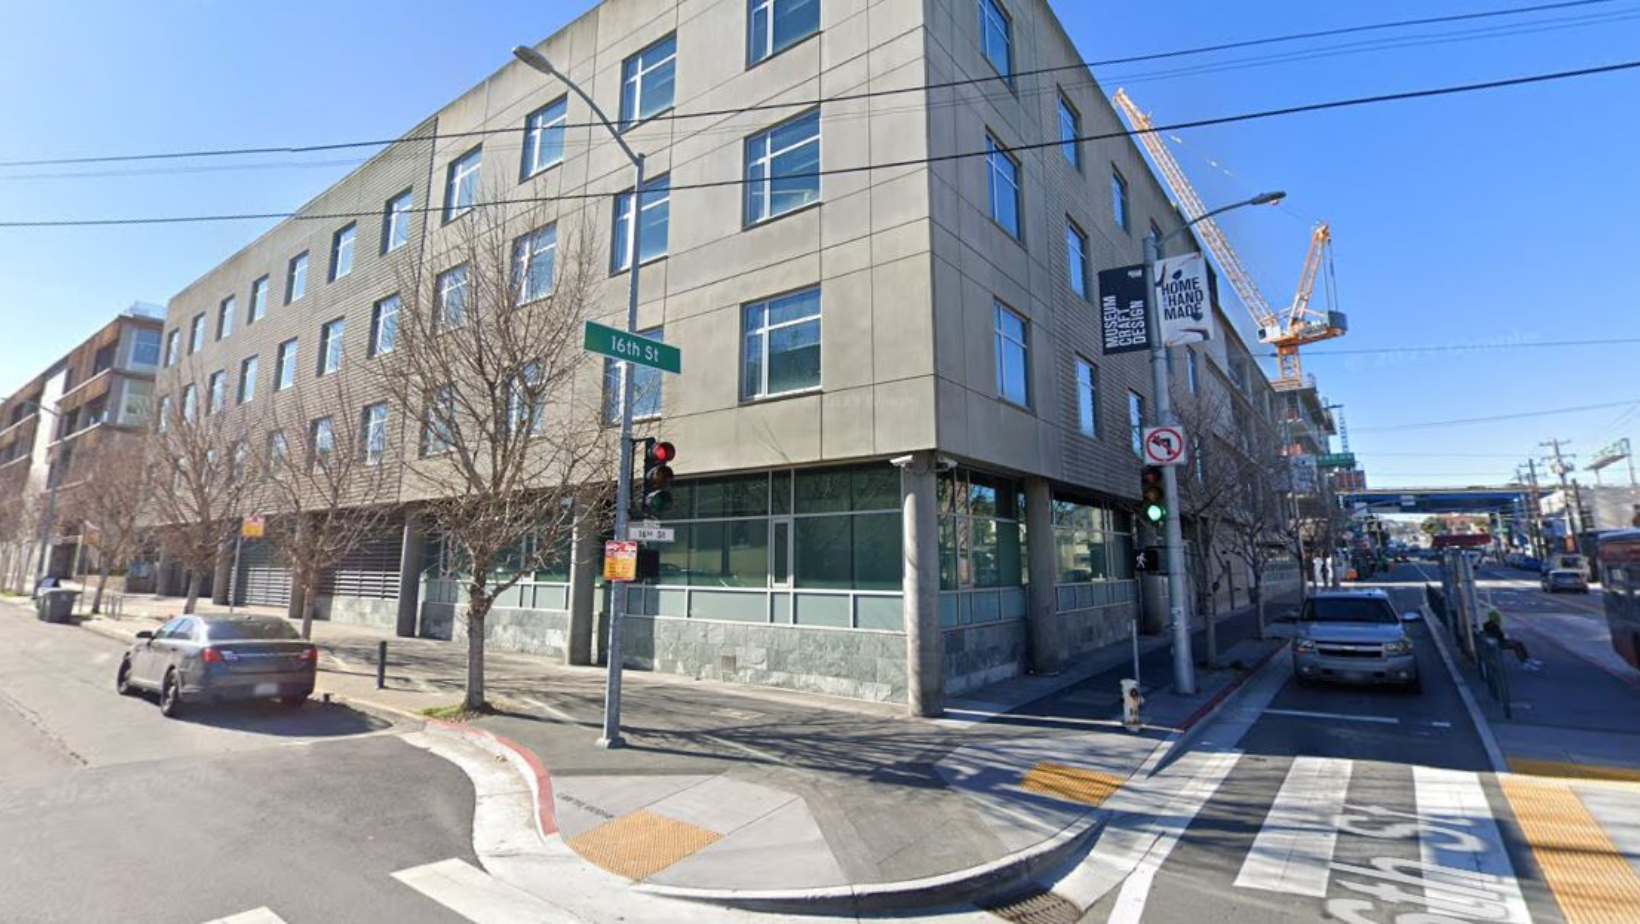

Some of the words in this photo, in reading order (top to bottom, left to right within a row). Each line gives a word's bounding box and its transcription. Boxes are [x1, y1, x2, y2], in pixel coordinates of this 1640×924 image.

[1161, 277, 1200, 296] HOME
[1167, 289, 1204, 307] HAND
[1102, 294, 1118, 349] MUSEUM
[1129, 300, 1147, 345] DESIGN
[1164, 303, 1203, 320] MADE
[1117, 308, 1132, 346] CRAFT
[611, 335, 640, 357] 16th
[645, 345, 659, 362] St
